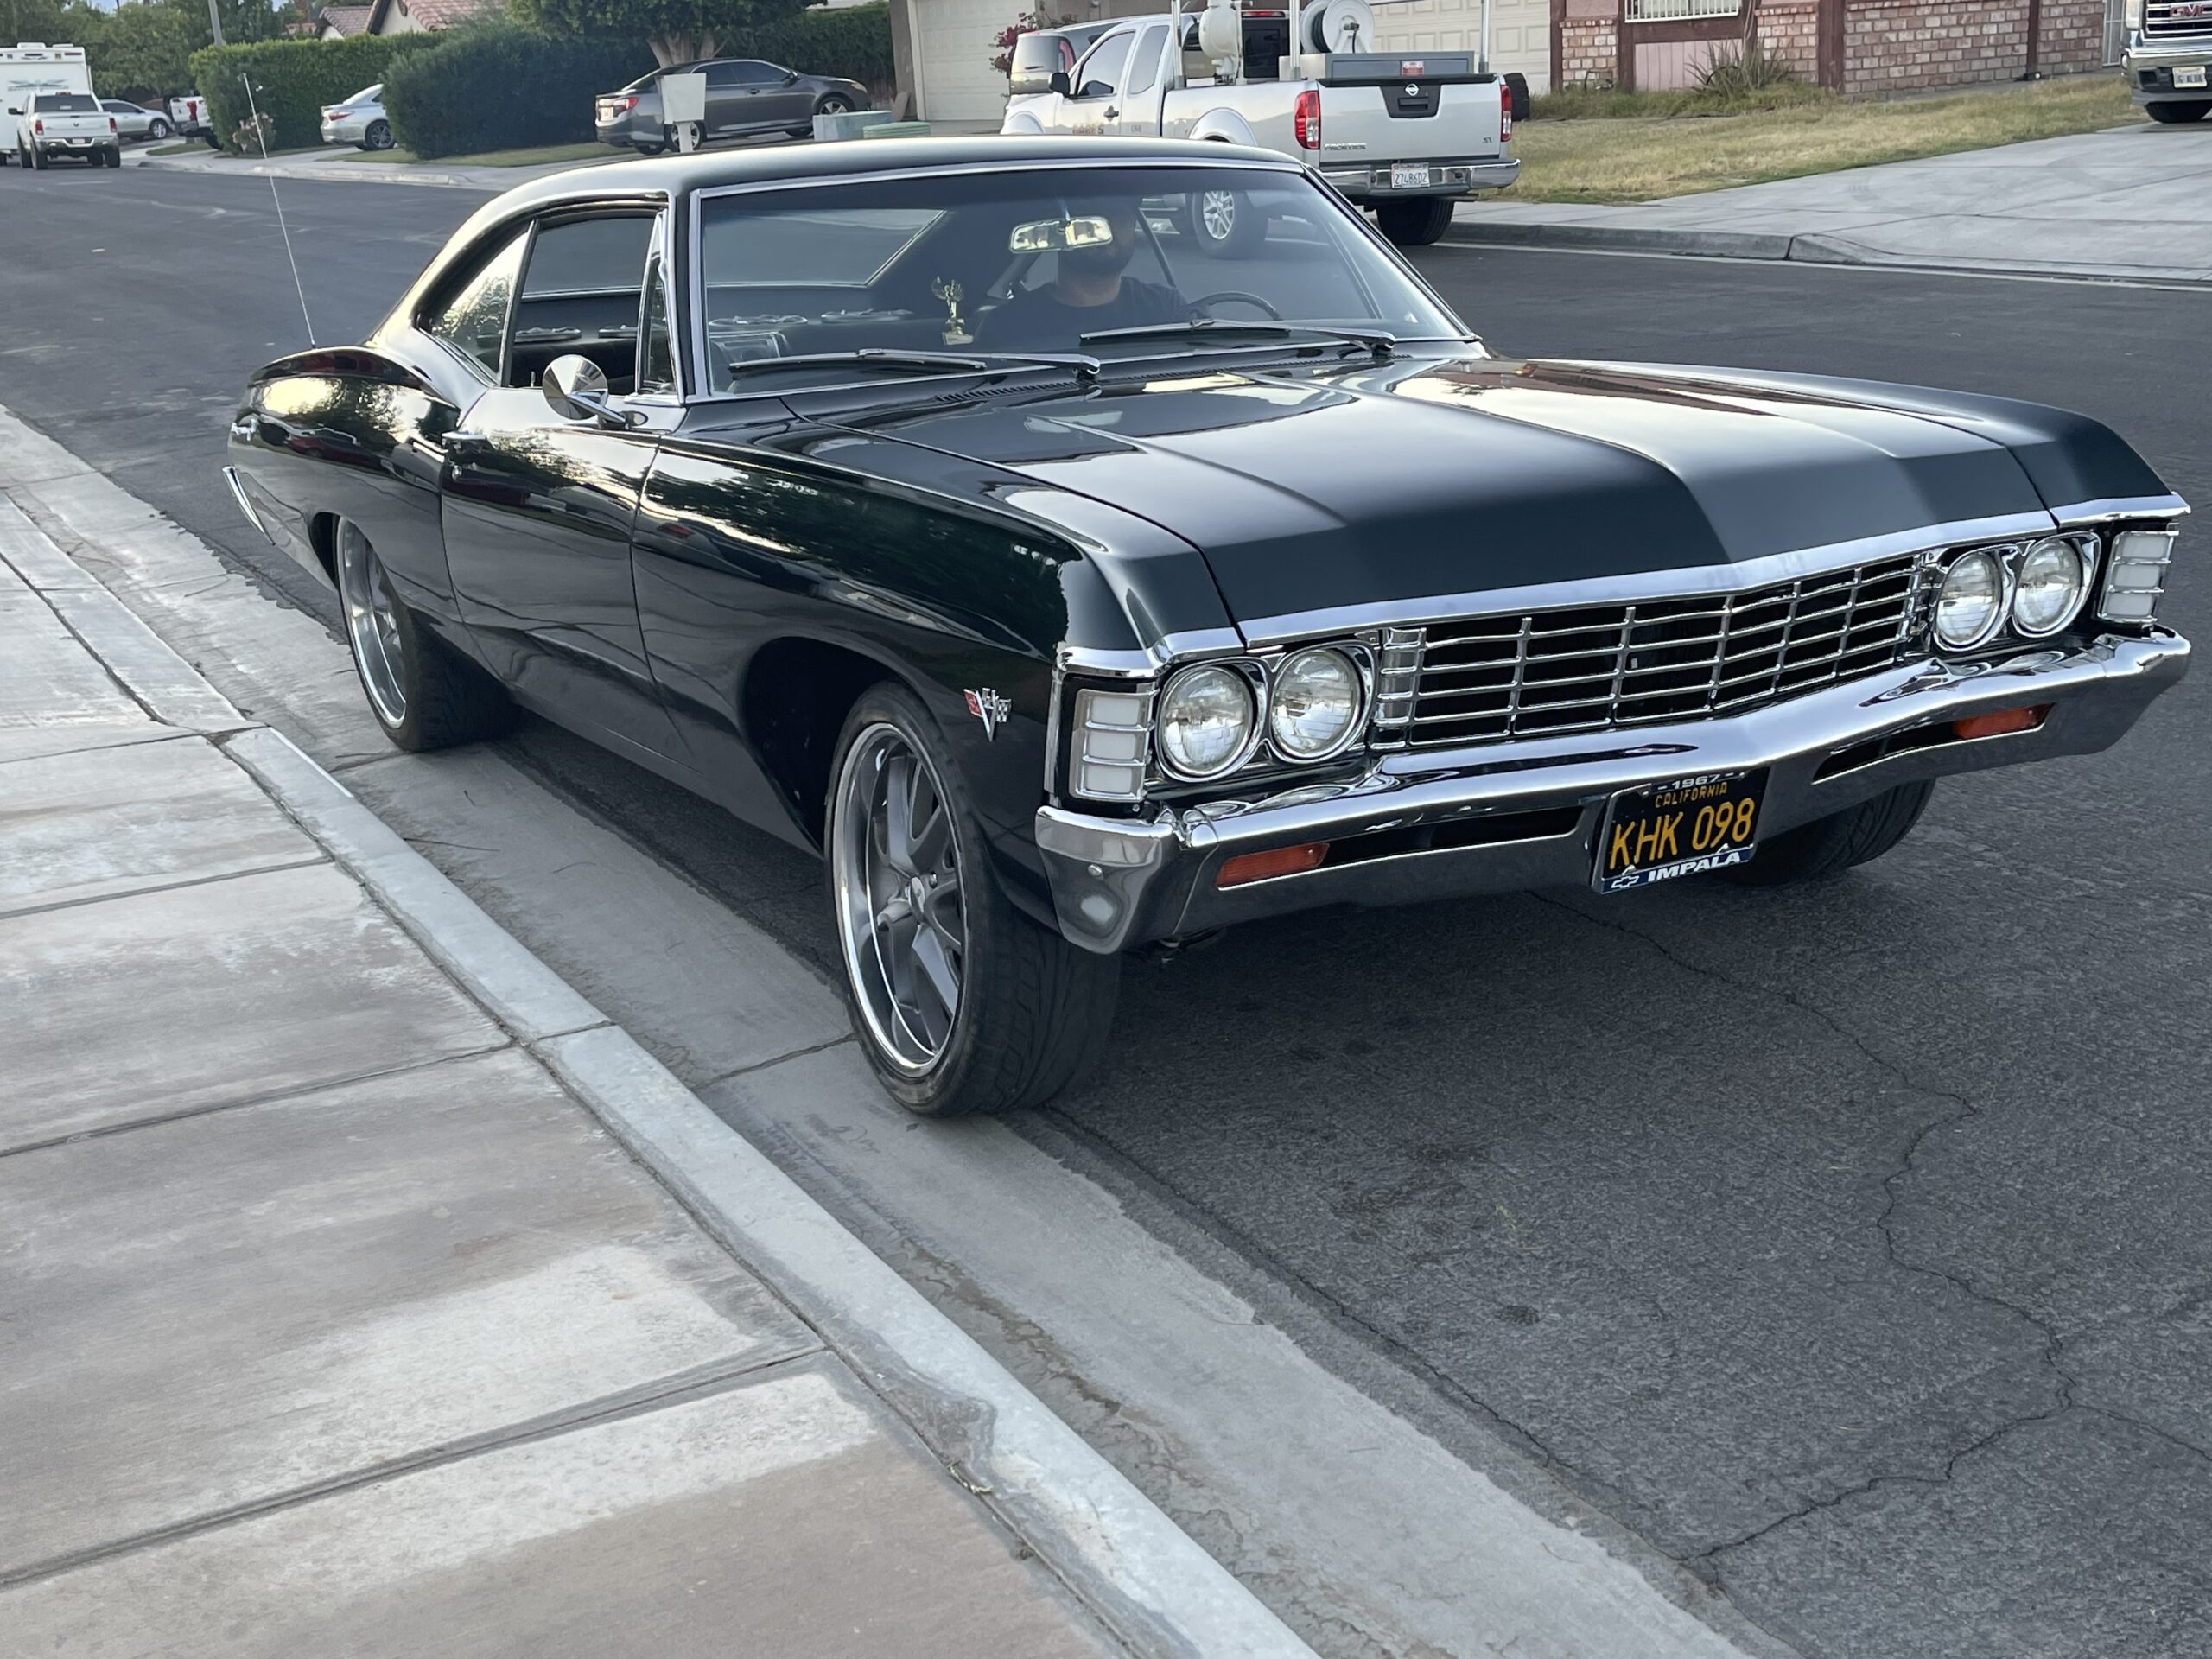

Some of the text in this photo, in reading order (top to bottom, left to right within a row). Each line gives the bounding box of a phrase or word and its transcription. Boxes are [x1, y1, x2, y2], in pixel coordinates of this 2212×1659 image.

[2171, 4, 2212, 17] GMC
[1655, 781, 1728, 809] CALIFORNIA
[1610, 798, 1756, 869] KHK 098
[1648, 852, 1741, 882] IMPALA
